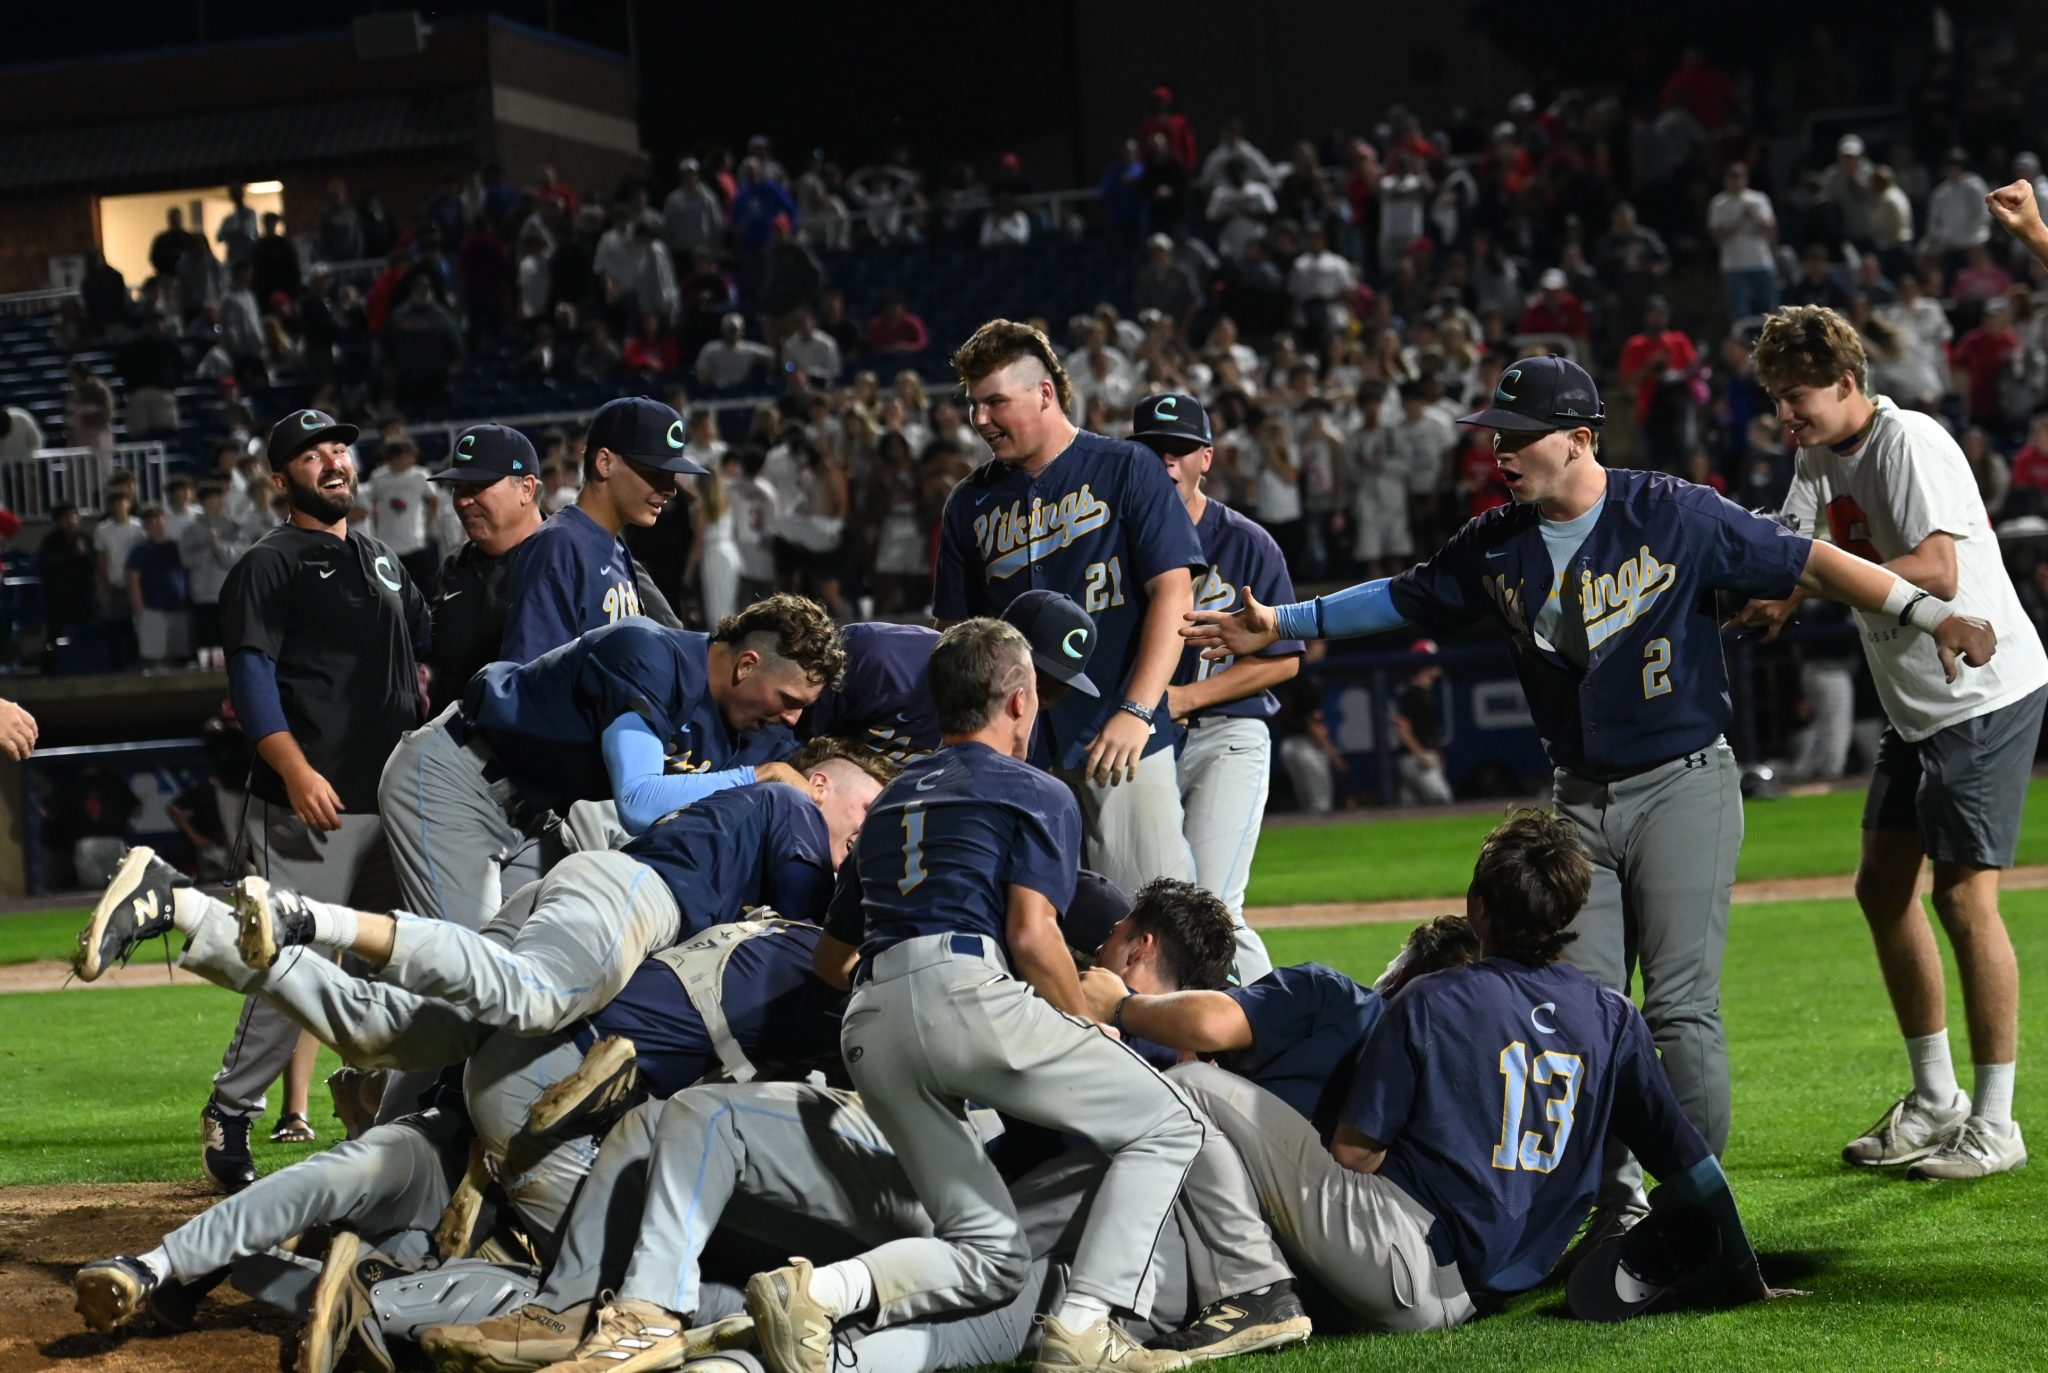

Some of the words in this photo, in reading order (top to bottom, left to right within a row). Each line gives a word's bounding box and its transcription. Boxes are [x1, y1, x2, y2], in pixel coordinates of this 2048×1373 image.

[1496, 369, 1522, 402] C
[301, 411, 326, 431] C
[1154, 396, 1179, 421] C
[455, 434, 476, 461] C
[666, 420, 685, 448] C
[973, 483, 1111, 587] Vikings
[374, 556, 402, 591] C
[1085, 554, 1125, 614] 21
[1062, 628, 1088, 659] C
[1641, 636, 1673, 700] 2
[915, 768, 945, 792] C
[897, 799, 928, 897] 1
[1531, 1002, 1556, 1034] C
[1491, 1040, 1585, 1175] 13
